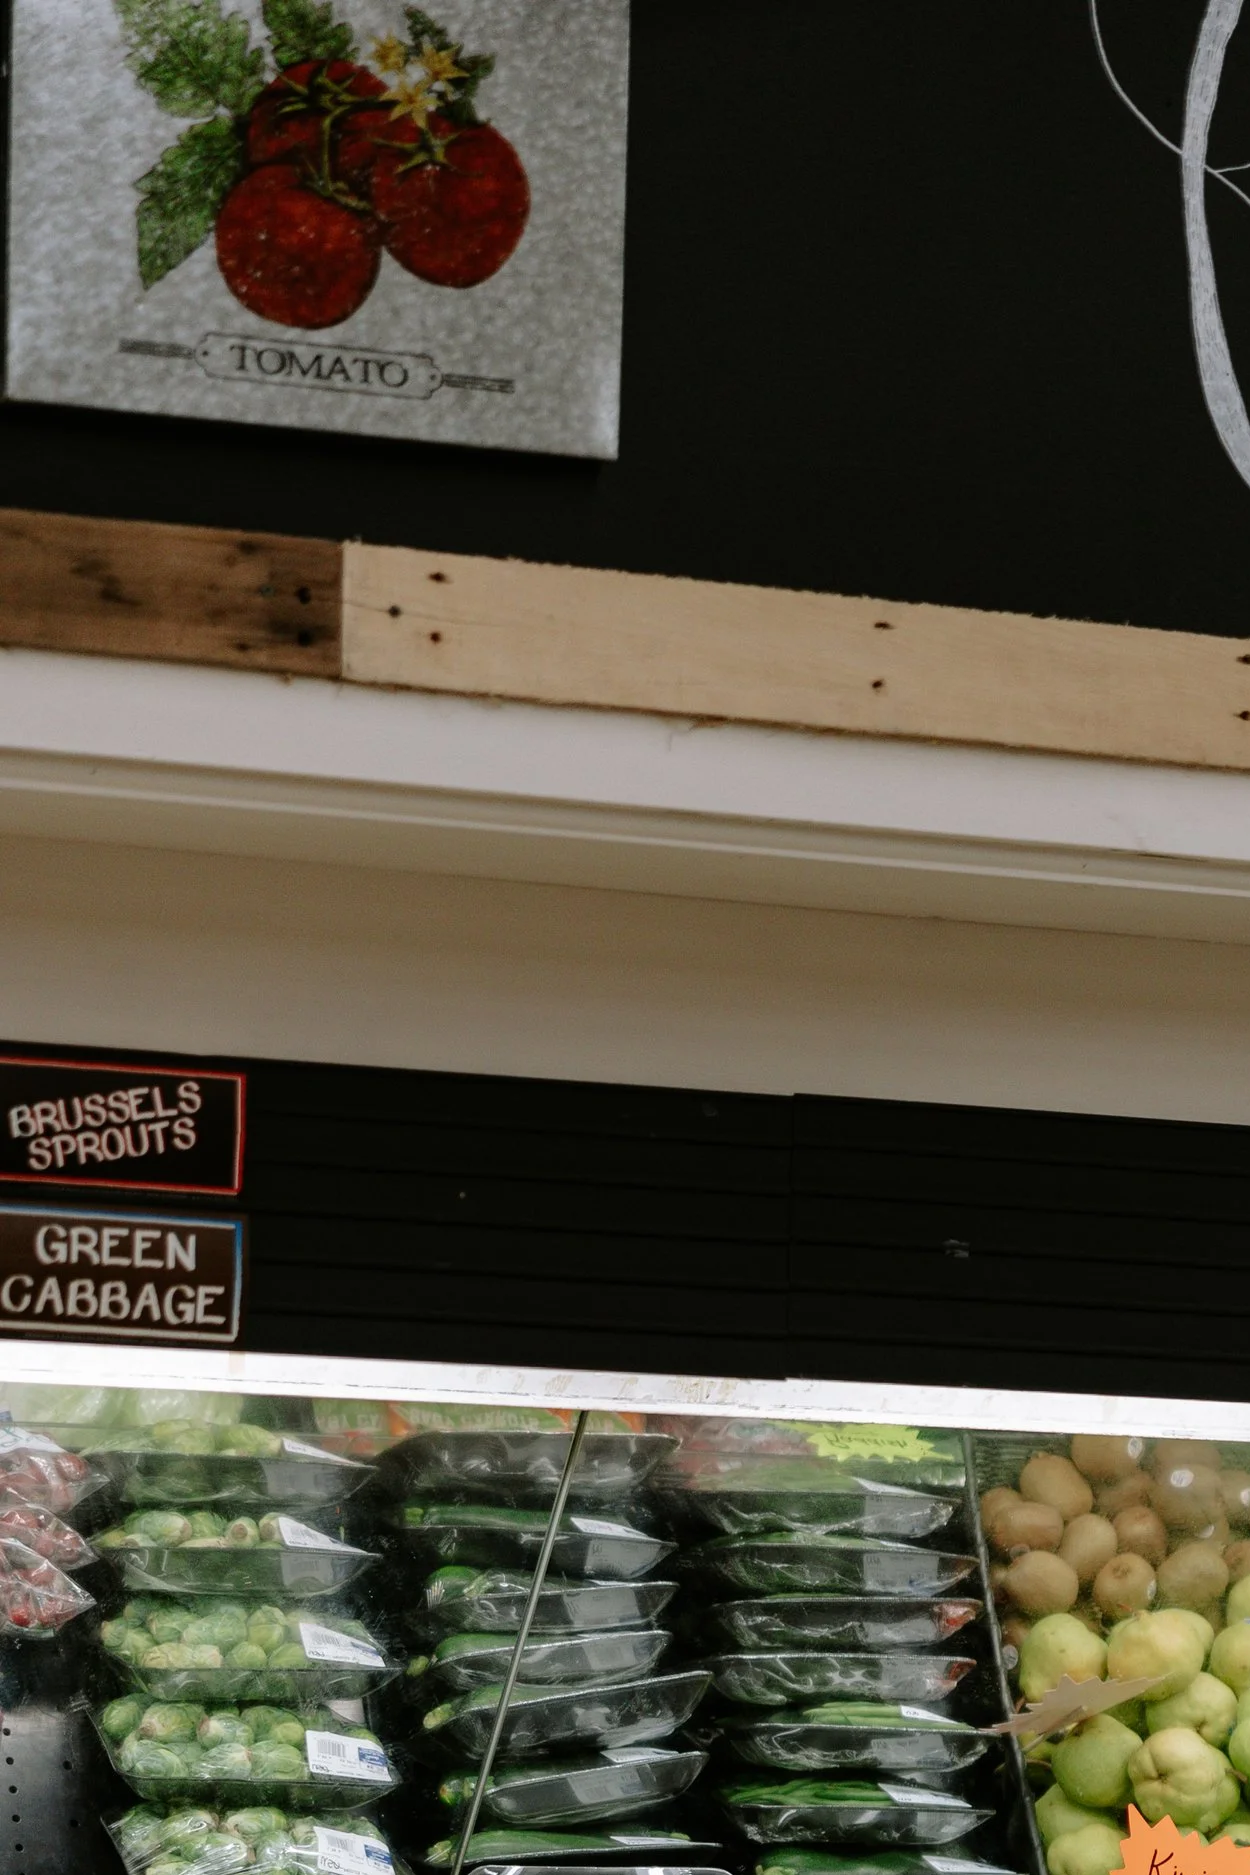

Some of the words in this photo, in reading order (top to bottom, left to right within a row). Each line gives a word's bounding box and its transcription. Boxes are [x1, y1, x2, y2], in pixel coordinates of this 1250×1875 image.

[230, 345, 409, 388] TOMATO
[8, 1081, 202, 1139] BRUSSELS
[28, 1117, 197, 1171] SPROUTS
[36, 1223, 197, 1271] GREEN
[1, 1274, 227, 1325] CABBAGE
